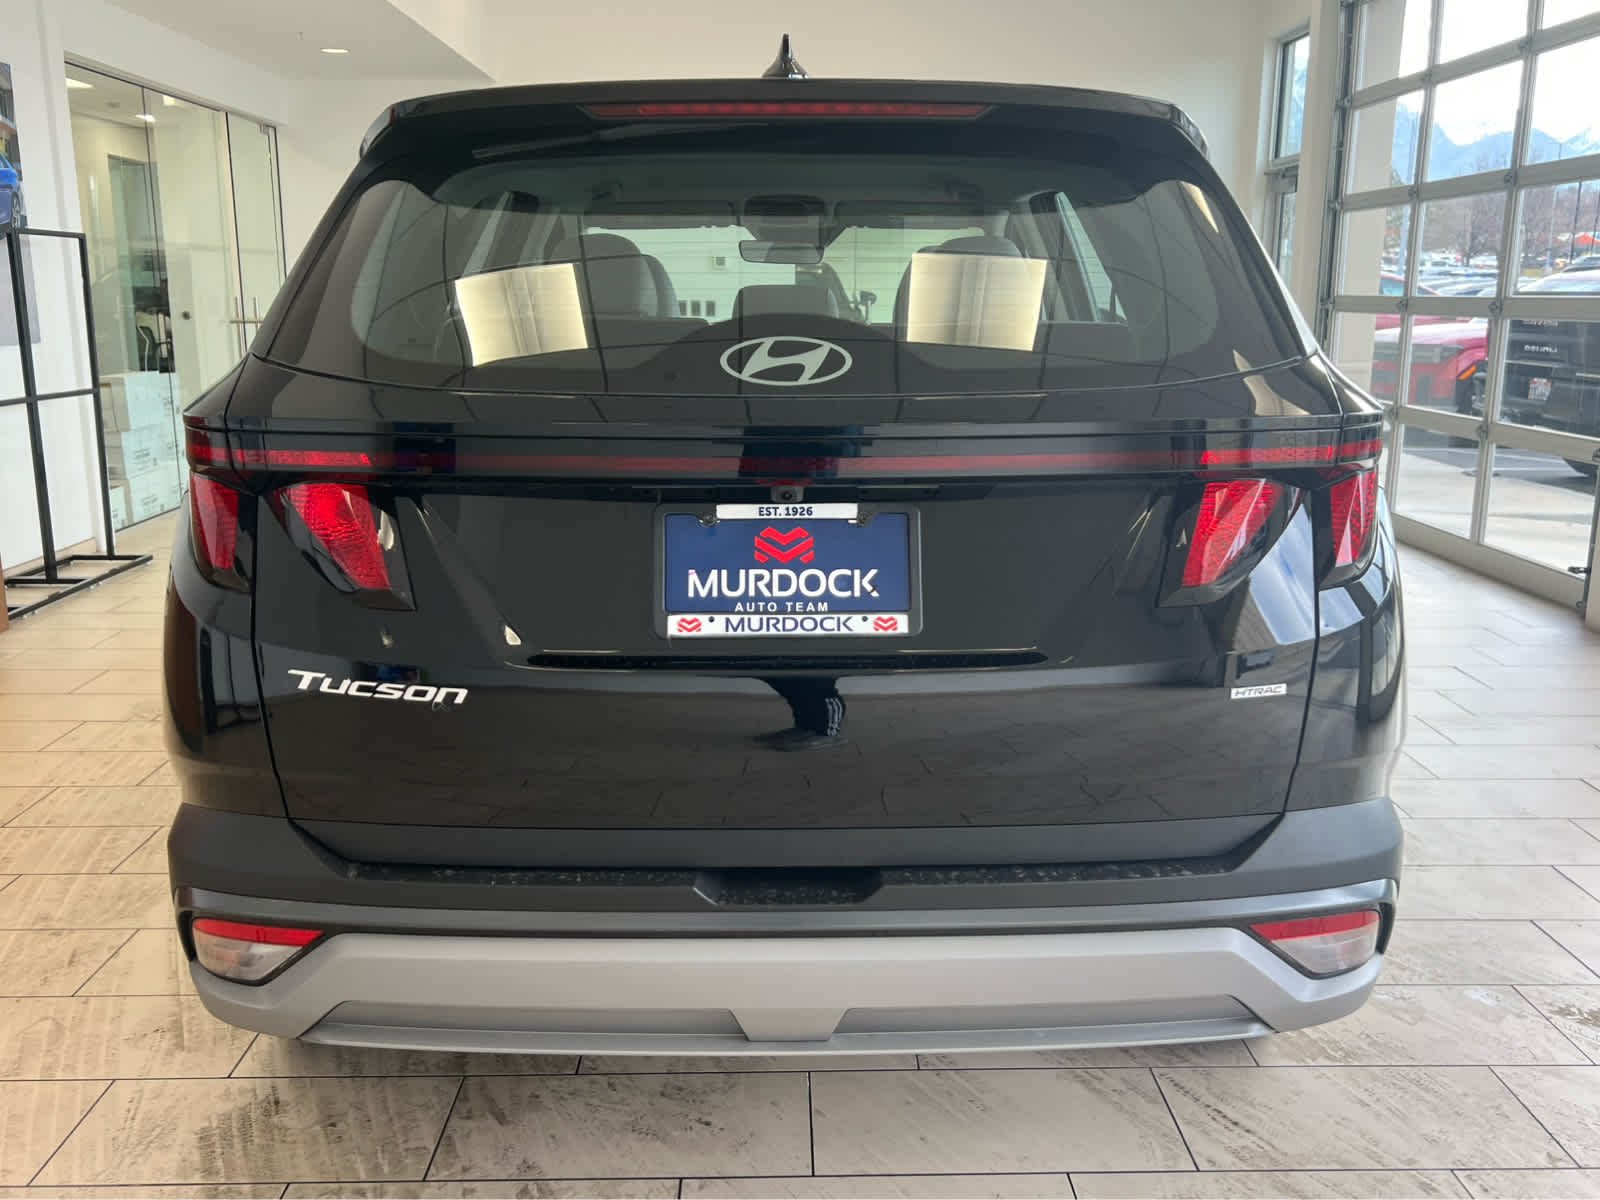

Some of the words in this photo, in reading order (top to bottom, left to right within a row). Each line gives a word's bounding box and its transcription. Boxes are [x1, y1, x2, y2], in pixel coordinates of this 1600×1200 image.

[758, 506, 782, 516] EST.
[784, 506, 813, 516] 1926
[688, 568, 879, 597] MURDOCK
[734, 602, 777, 612] AUTO
[785, 602, 828, 612] TEAM
[724, 616, 853, 632] MURDOCK
[1233, 685, 1283, 697] HTRAC
